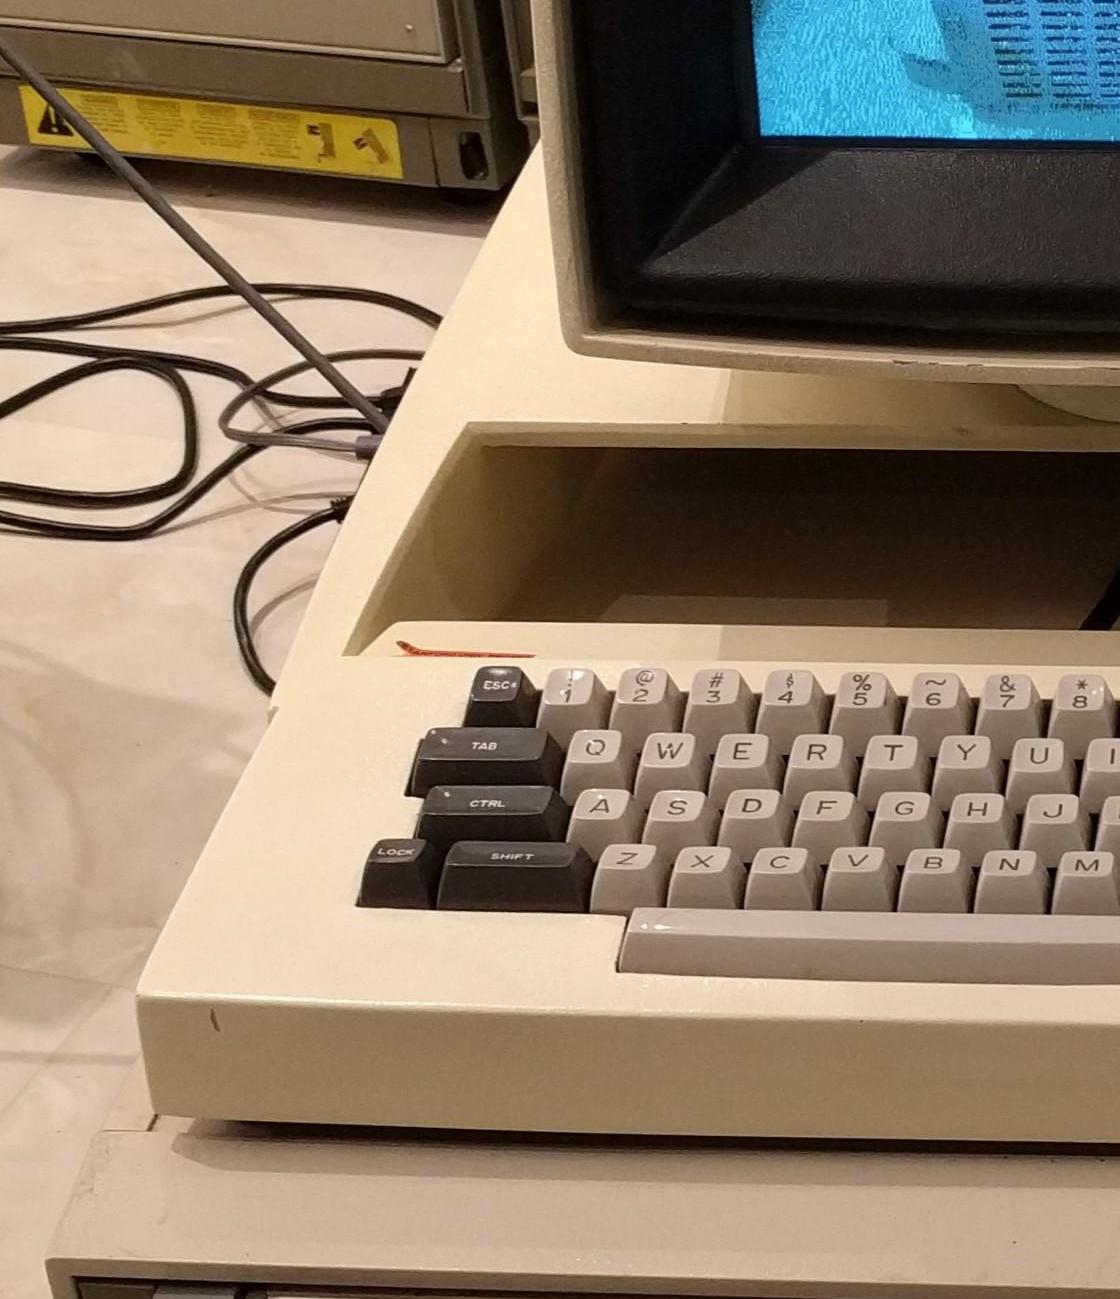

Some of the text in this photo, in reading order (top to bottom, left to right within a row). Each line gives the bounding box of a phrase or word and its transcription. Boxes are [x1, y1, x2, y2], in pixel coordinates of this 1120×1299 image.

[483, 680, 509, 690] ESC
[709, 672, 725, 688] #
[786, 673, 794, 689] $
[852, 674, 872, 691] %
[999, 675, 1016, 693] &
[632, 689, 648, 702] 2
[705, 691, 721, 703] 3
[777, 691, 794, 703] 4
[852, 692, 868, 706] 5
[925, 692, 942, 706] 6
[999, 694, 1015, 708] 7
[1072, 695, 1088, 709] 8
[471, 741, 498, 750] TAB
[585, 739, 606, 756] Q
[656, 742, 684, 760] W
[732, 742, 753, 760] E
[806, 744, 828, 761] R
[884, 744, 904, 761] T
[957, 744, 977, 761] Y
[1029, 747, 1050, 764] U
[469, 799, 506, 808] CTRL
[588, 798, 610, 813] A
[667, 800, 688, 815] S
[741, 798, 762, 813] D
[815, 800, 838, 815] F
[894, 800, 915, 816] G
[966, 801, 988, 817] H
[1042, 803, 1063, 819] J
[377, 847, 414, 855] LOCK
[490, 852, 535, 860] SHIFT
[615, 852, 639, 865] Z
[690, 854, 715, 868] X
[769, 855, 790, 869] C
[847, 854, 869, 868] V
[924, 856, 944, 869] B
[998, 857, 1021, 871] N
[1074, 859, 1100, 872] M
